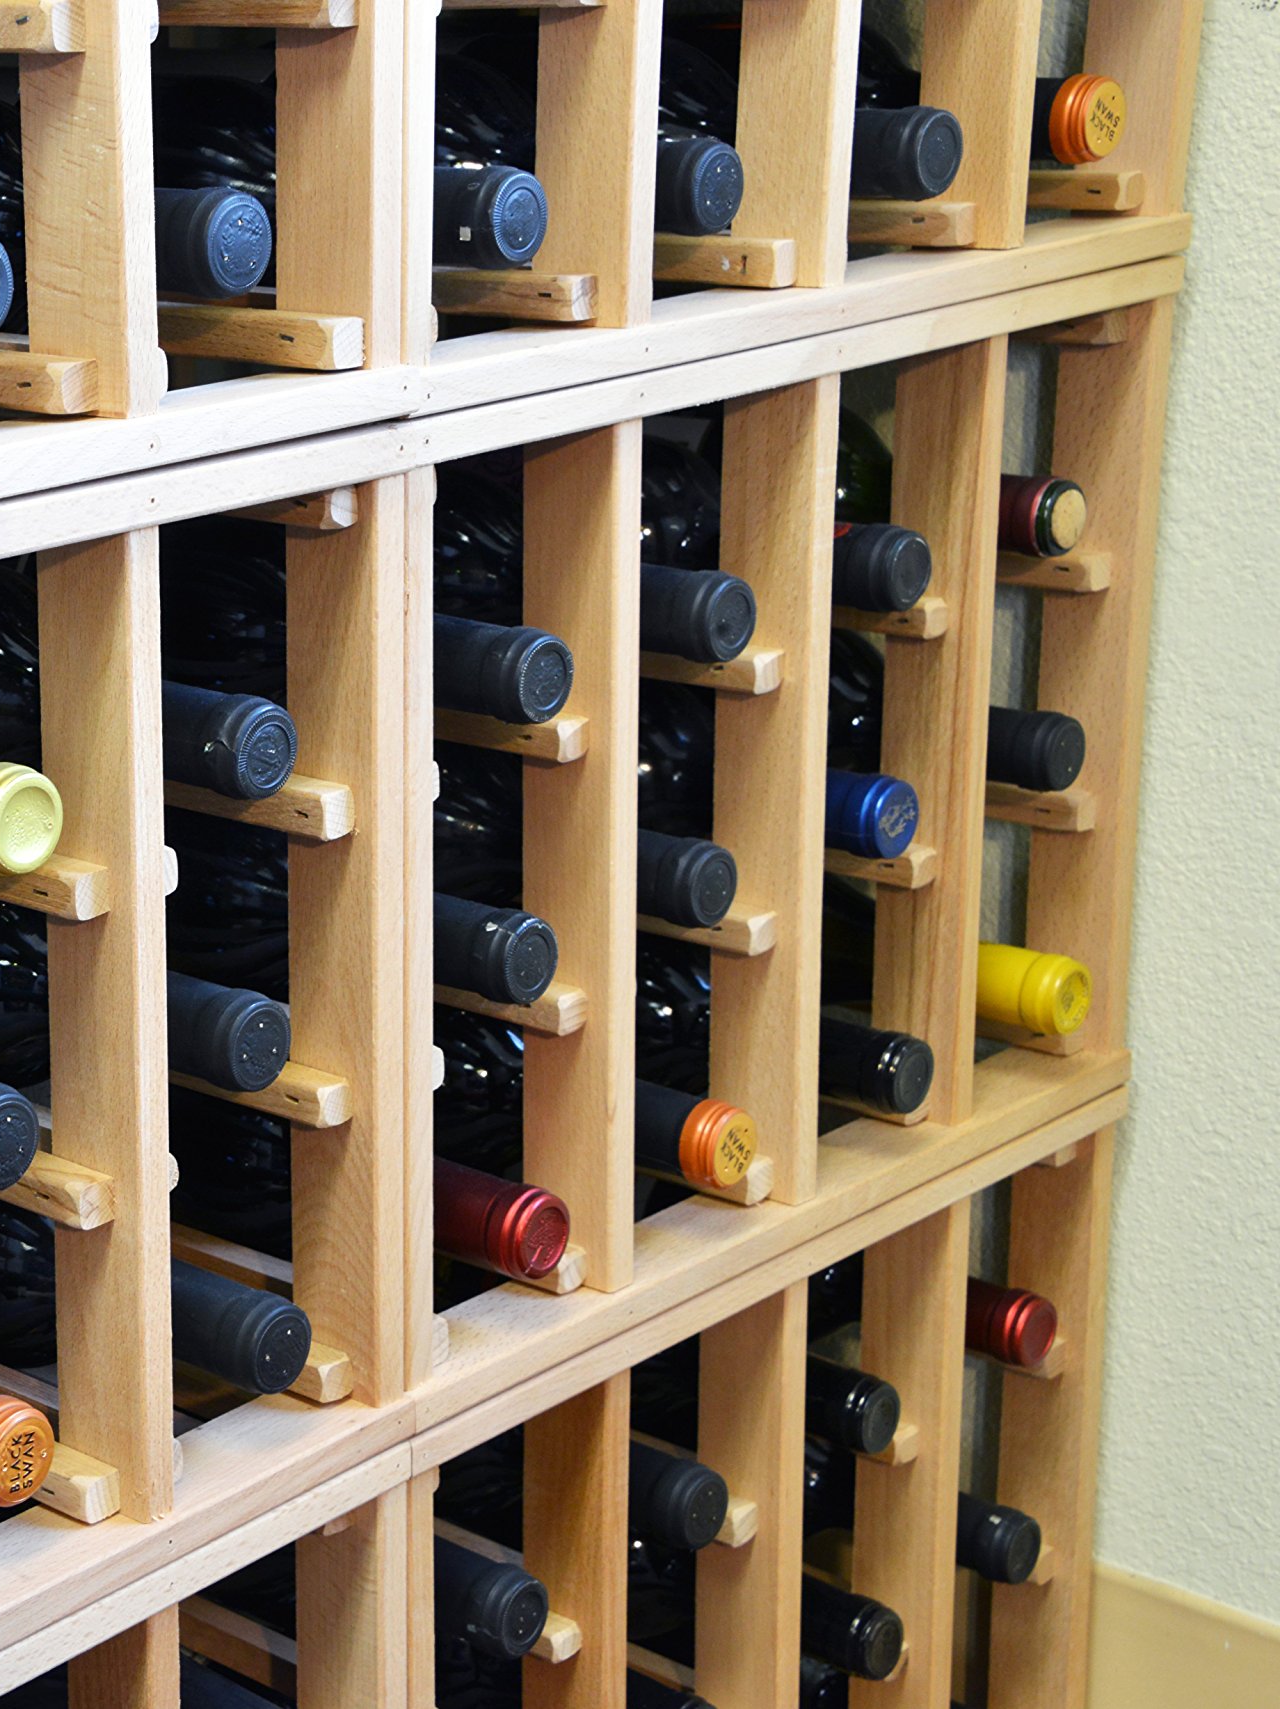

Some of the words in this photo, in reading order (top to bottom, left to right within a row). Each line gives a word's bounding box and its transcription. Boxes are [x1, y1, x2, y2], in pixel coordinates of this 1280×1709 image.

[1089, 110, 1115, 142] BLACK
[1095, 97, 1121, 128] SWAN
[720, 1142, 744, 1174] BLACK
[726, 1128, 751, 1161] SWAN
[9, 1433, 23, 1494] BLACK
[23, 1431, 35, 1490] SWAN
